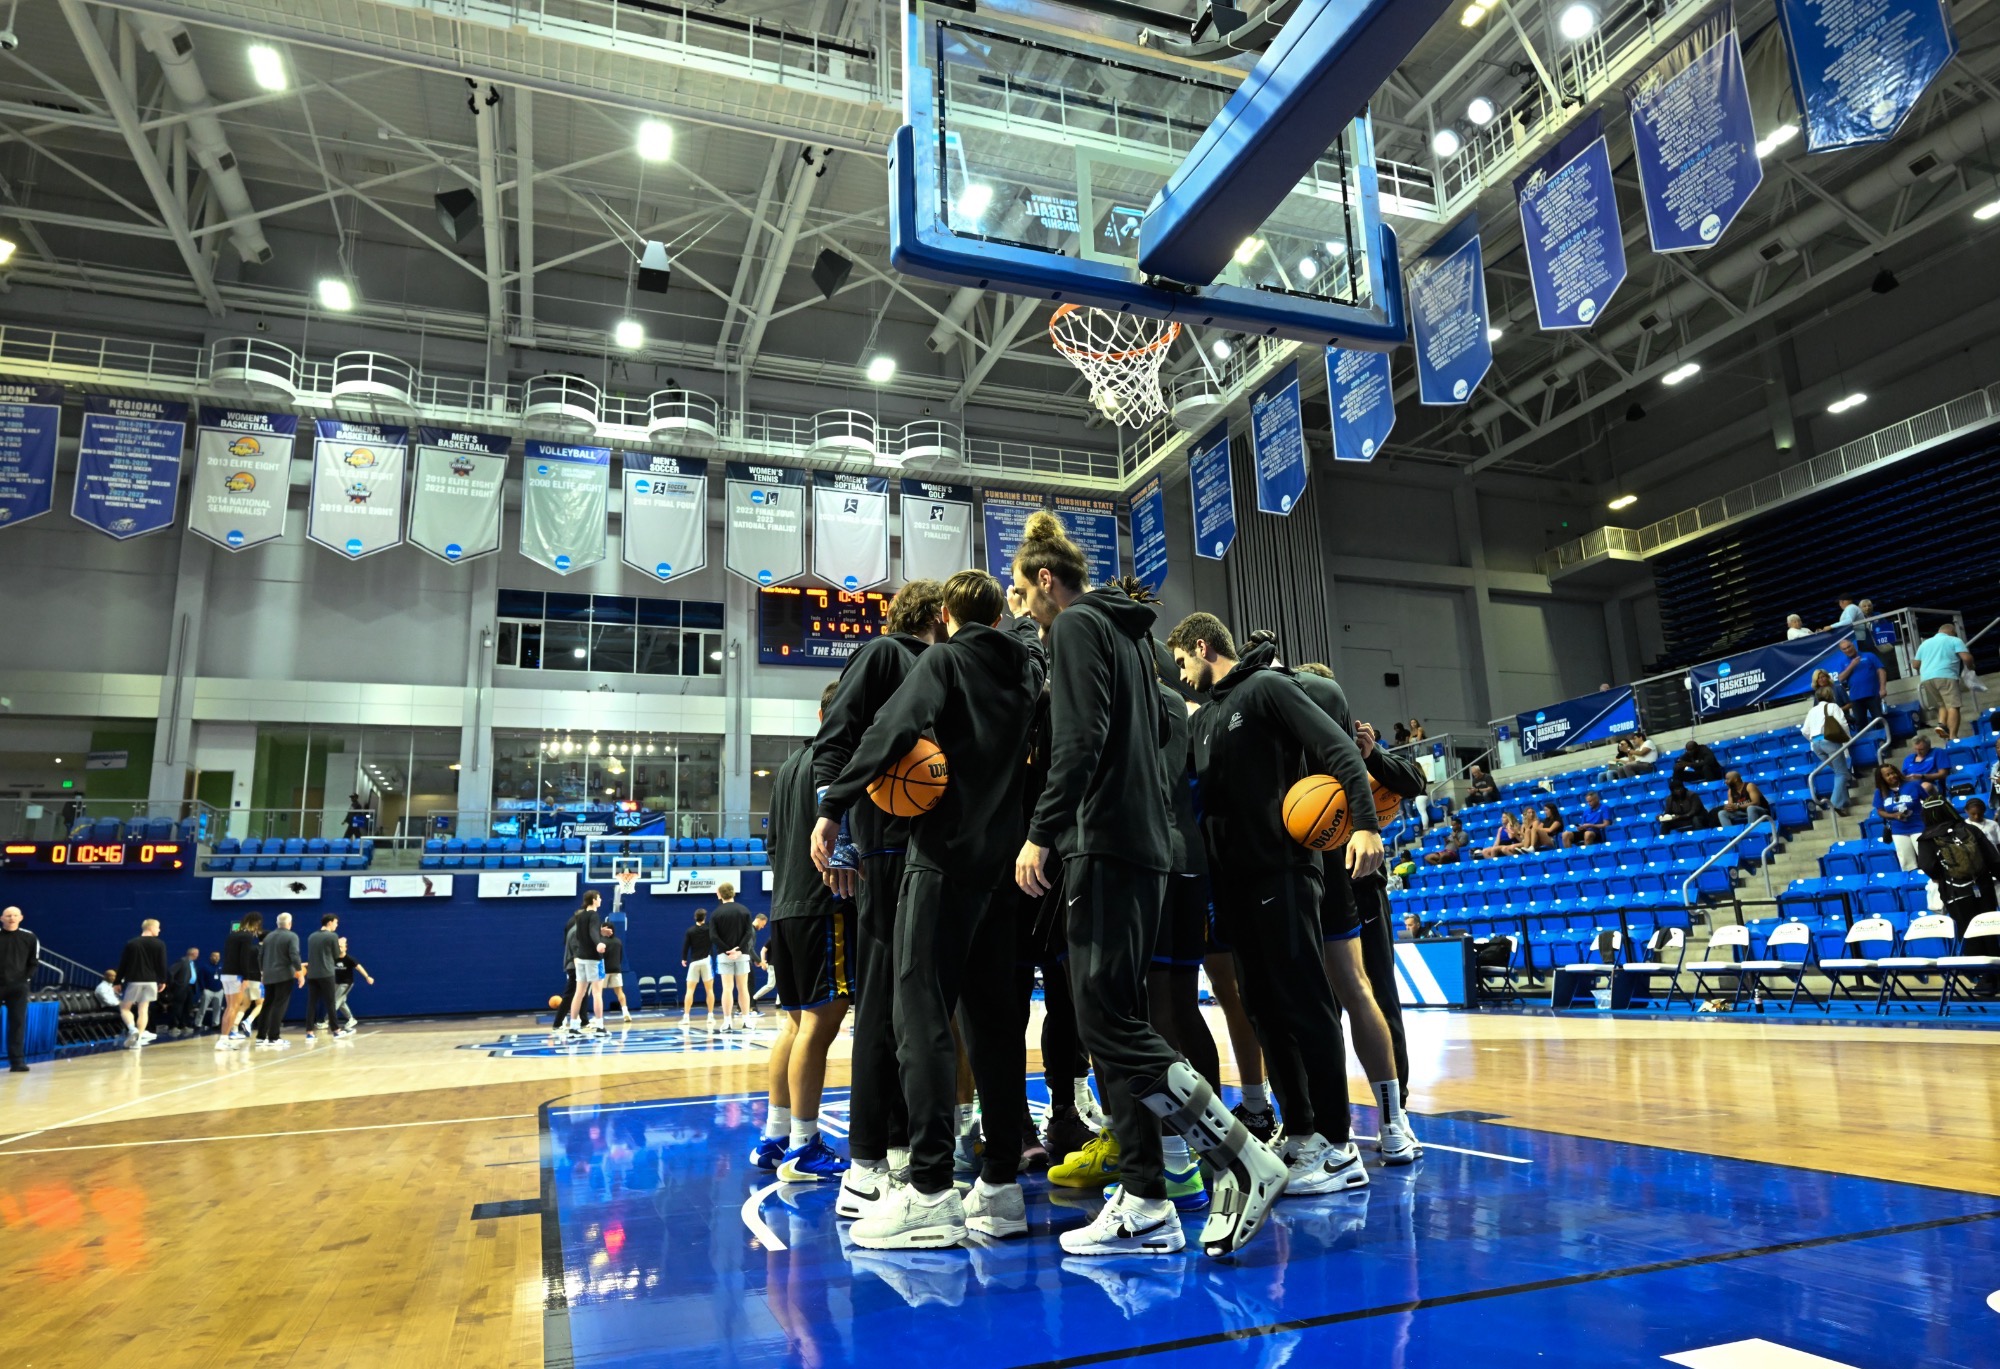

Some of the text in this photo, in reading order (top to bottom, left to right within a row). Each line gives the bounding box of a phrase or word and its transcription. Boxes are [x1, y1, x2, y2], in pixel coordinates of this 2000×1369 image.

[1665, 64, 1698, 97] 2014-2015
[1679, 143, 1712, 173] 2015-2016
[1547, 164, 1574, 192] 2012-2013
[1520, 170, 1547, 205] NSU
[1704, 222, 1722, 236] NCAA
[1558, 226, 1586, 253] 2013-2014
[0, 386, 38, 396] IONAL
[109, 399, 164, 413] REGIONAL
[116, 409, 156, 419] CHAMPIONS
[227, 412, 268, 423] WOMEN'S
[220, 420, 275, 432] BASKETBALL
[343, 423, 381, 434] WOMEN'S
[336, 431, 387, 443] BASKETBALL
[452, 433, 478, 444] MEN'S
[438, 439, 489, 453] BASKETBALL
[539, 445, 596, 460] VOLLEYBALL
[207, 458, 280, 472] 2013 ELITE EIGHT
[653, 456, 677, 466] MEN'S
[650, 464, 680, 474] SOCCER
[749, 466, 783, 477] WOMEN'S
[426, 474, 494, 489] 2019 ELITE EIGHT
[753, 473, 778, 483] TENNIS
[835, 475, 868, 484] WOMEN'S
[425, 484, 494, 498] 2022 ELITE EIGHT
[529, 478, 602, 493] 2008 ELITE EIGHT
[834, 481, 869, 492] SOFTBALL
[922, 483, 953, 493] WOMEN'S
[1147, 478, 1159, 492] STATE
[928, 491, 946, 499] GOLF
[985, 490, 1043, 503] SUNSHINE STATE
[207, 496, 272, 508] 2014 NATIONAL
[654, 500, 675, 508] FINAL
[676, 502, 696, 510] FOUR
[1056, 497, 1114, 510] SUNSHINE STATE
[208, 504, 268, 516] SEMIFINALIST
[320, 503, 394, 516] 2019 ELITE EIGHT
[736, 506, 796, 519] 2022 FINAL FOUR
[1058, 505, 1086, 513] CONFERENCE
[757, 515, 774, 524] 2023
[733, 520, 797, 533] NATIONAL FINALIST
[914, 522, 961, 534] 2023 NATIONAL
[924, 532, 951, 541] FINALIST
[820, 596, 827, 608] 0
[839, 591, 864, 603] 10:46
[880, 600, 887, 612] 0
[814, 622, 820, 631] 0
[828, 623, 835, 632] 4
[853, 624, 859, 633] 0
[865, 625, 871, 634] 4
[782, 646, 789, 655] 0
[813, 646, 830, 656] THE
[1720, 672, 1766, 692] BASKETBALL
[1720, 684, 1760, 699] CHAMPIONSHIP
[1537, 721, 1571, 737] BASKETBALL
[1609, 721, 1634, 733] #D2MBB
[1538, 731, 1566, 743] CHAMPIONSHIP
[1309, 808, 1344, 850] Wilson
[52, 846, 66, 863] 0
[78, 846, 122, 863] 10:46
[141, 845, 154, 863] 0
